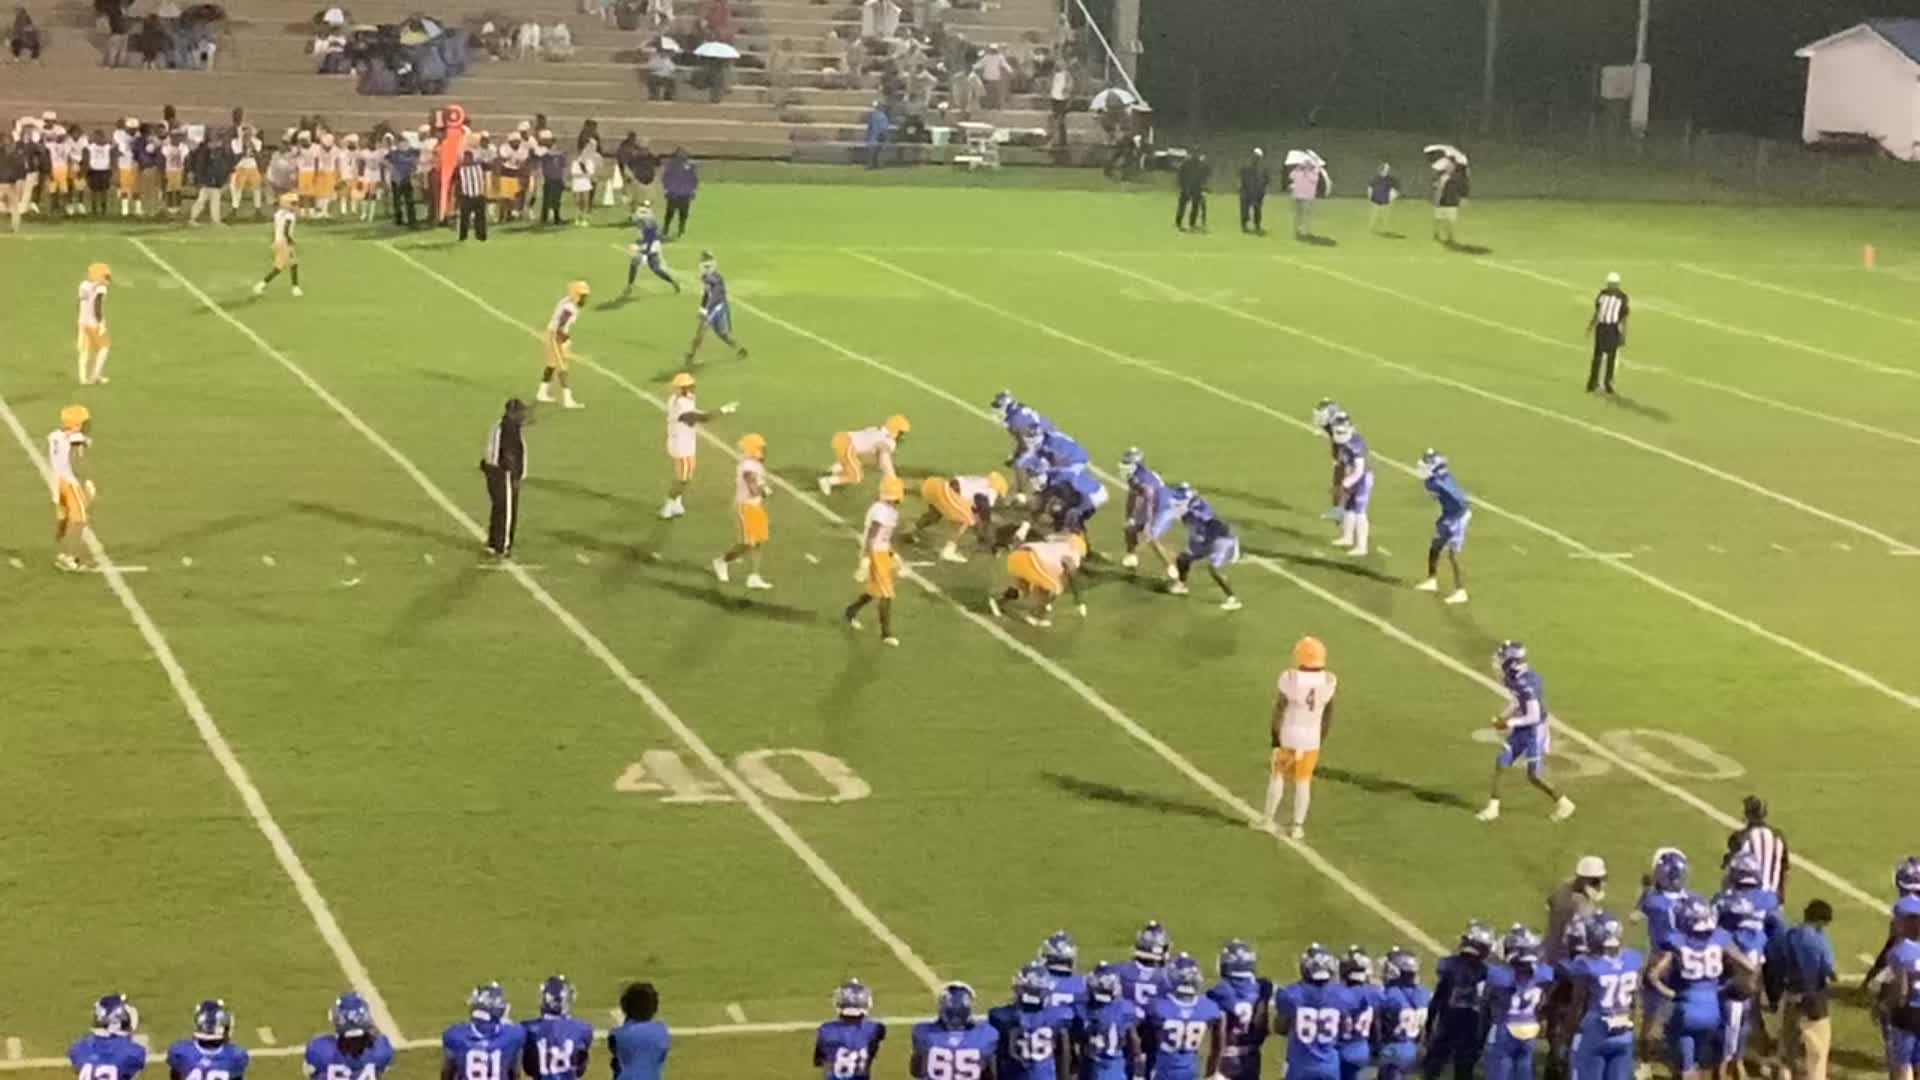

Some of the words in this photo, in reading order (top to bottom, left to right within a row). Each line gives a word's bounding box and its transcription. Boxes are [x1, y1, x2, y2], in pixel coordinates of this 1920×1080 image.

[1305, 687, 1316, 712] 4
[613, 749, 871, 803] 40
[1681, 945, 1723, 980] 58
[1160, 1020, 1206, 1052] 38
[465, 1049, 501, 1080] 61
[927, 1046, 981, 1080] 65
